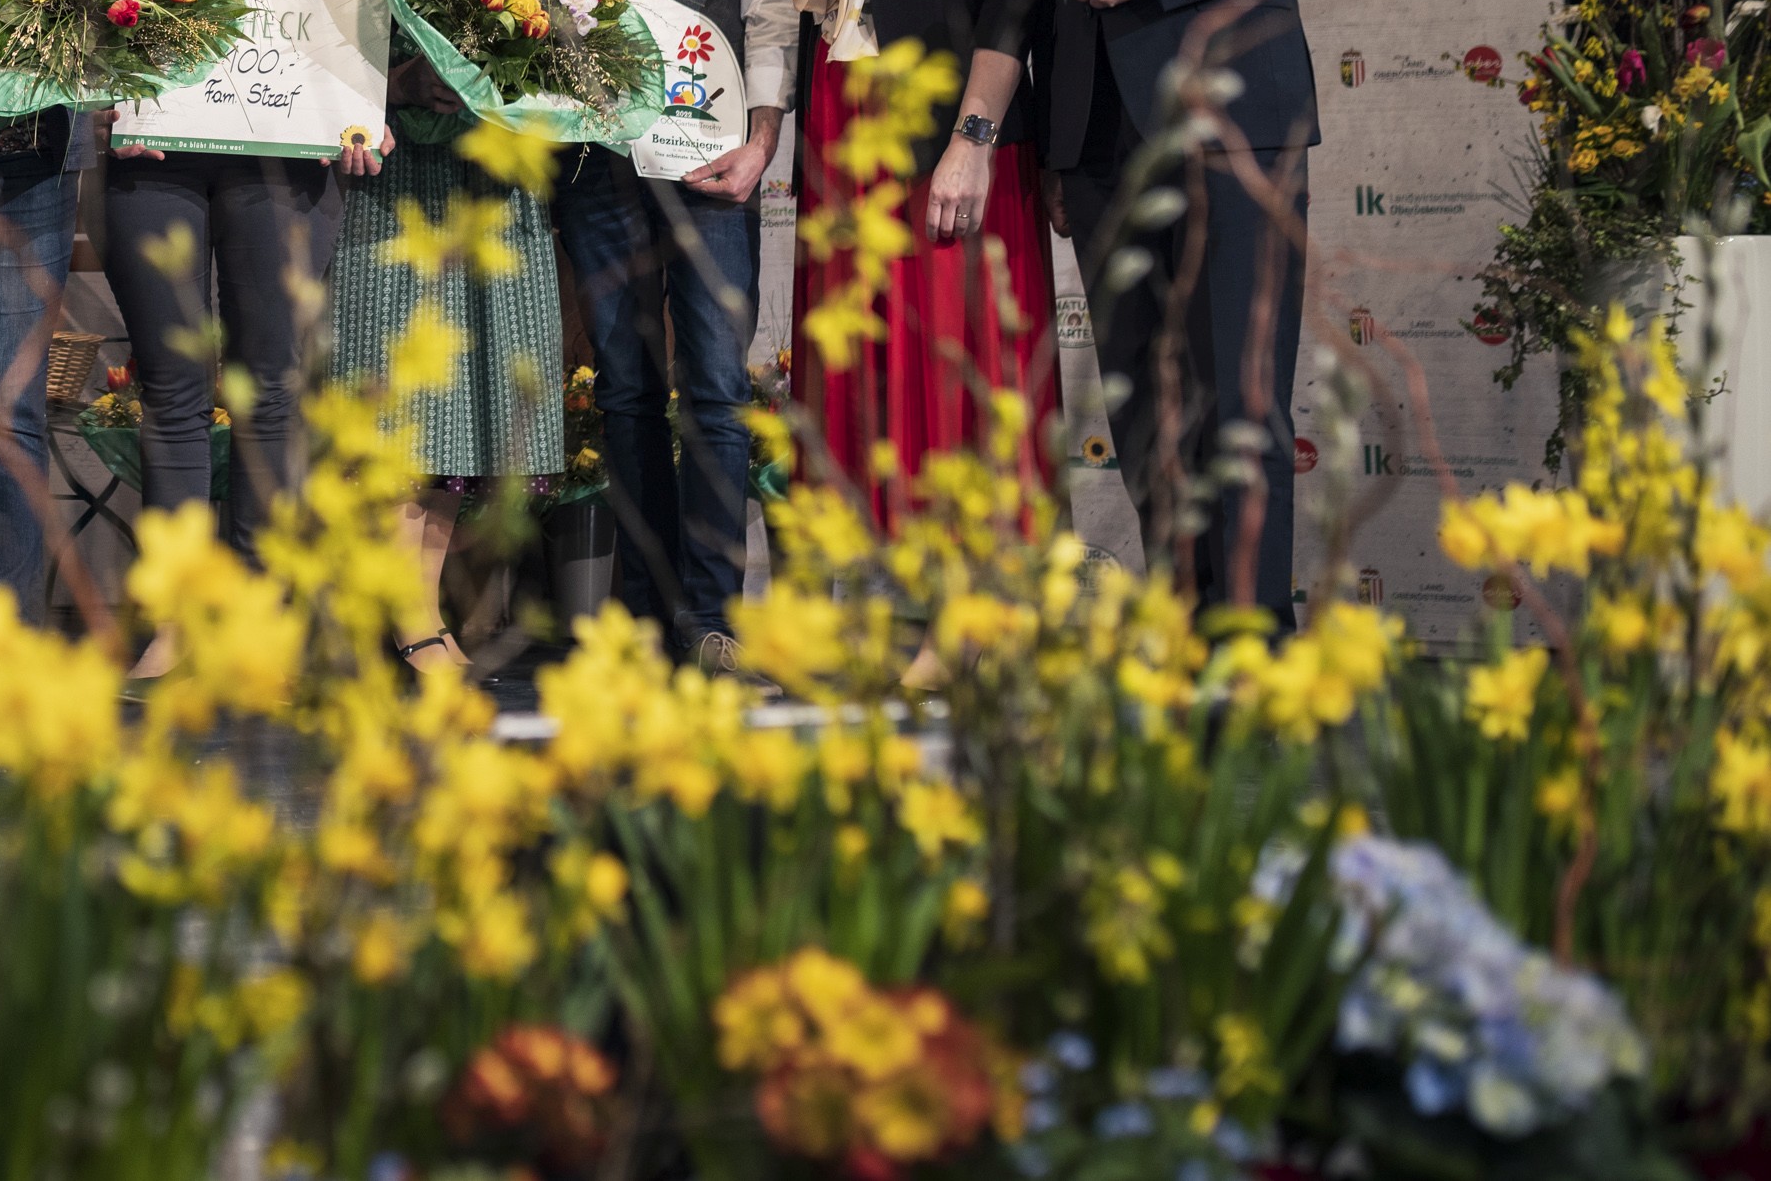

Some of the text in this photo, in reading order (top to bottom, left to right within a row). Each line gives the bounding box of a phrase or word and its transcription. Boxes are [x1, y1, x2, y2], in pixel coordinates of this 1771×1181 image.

[242, 10, 313, 41] HECK
[204, 79, 302, 118] Fam. Streif
[675, 110, 692, 118] 2022
[676, 119, 722, 132] Garten-Trophy
[122, 138, 133, 146] Die
[147, 139, 172, 147] Gärtner
[189, 141, 207, 149] blüht
[229, 144, 245, 152] was!
[652, 133, 724, 153] Bezirkssieger
[760, 204, 795, 217] Garte
[1059, 328, 1090, 339] ARTE
